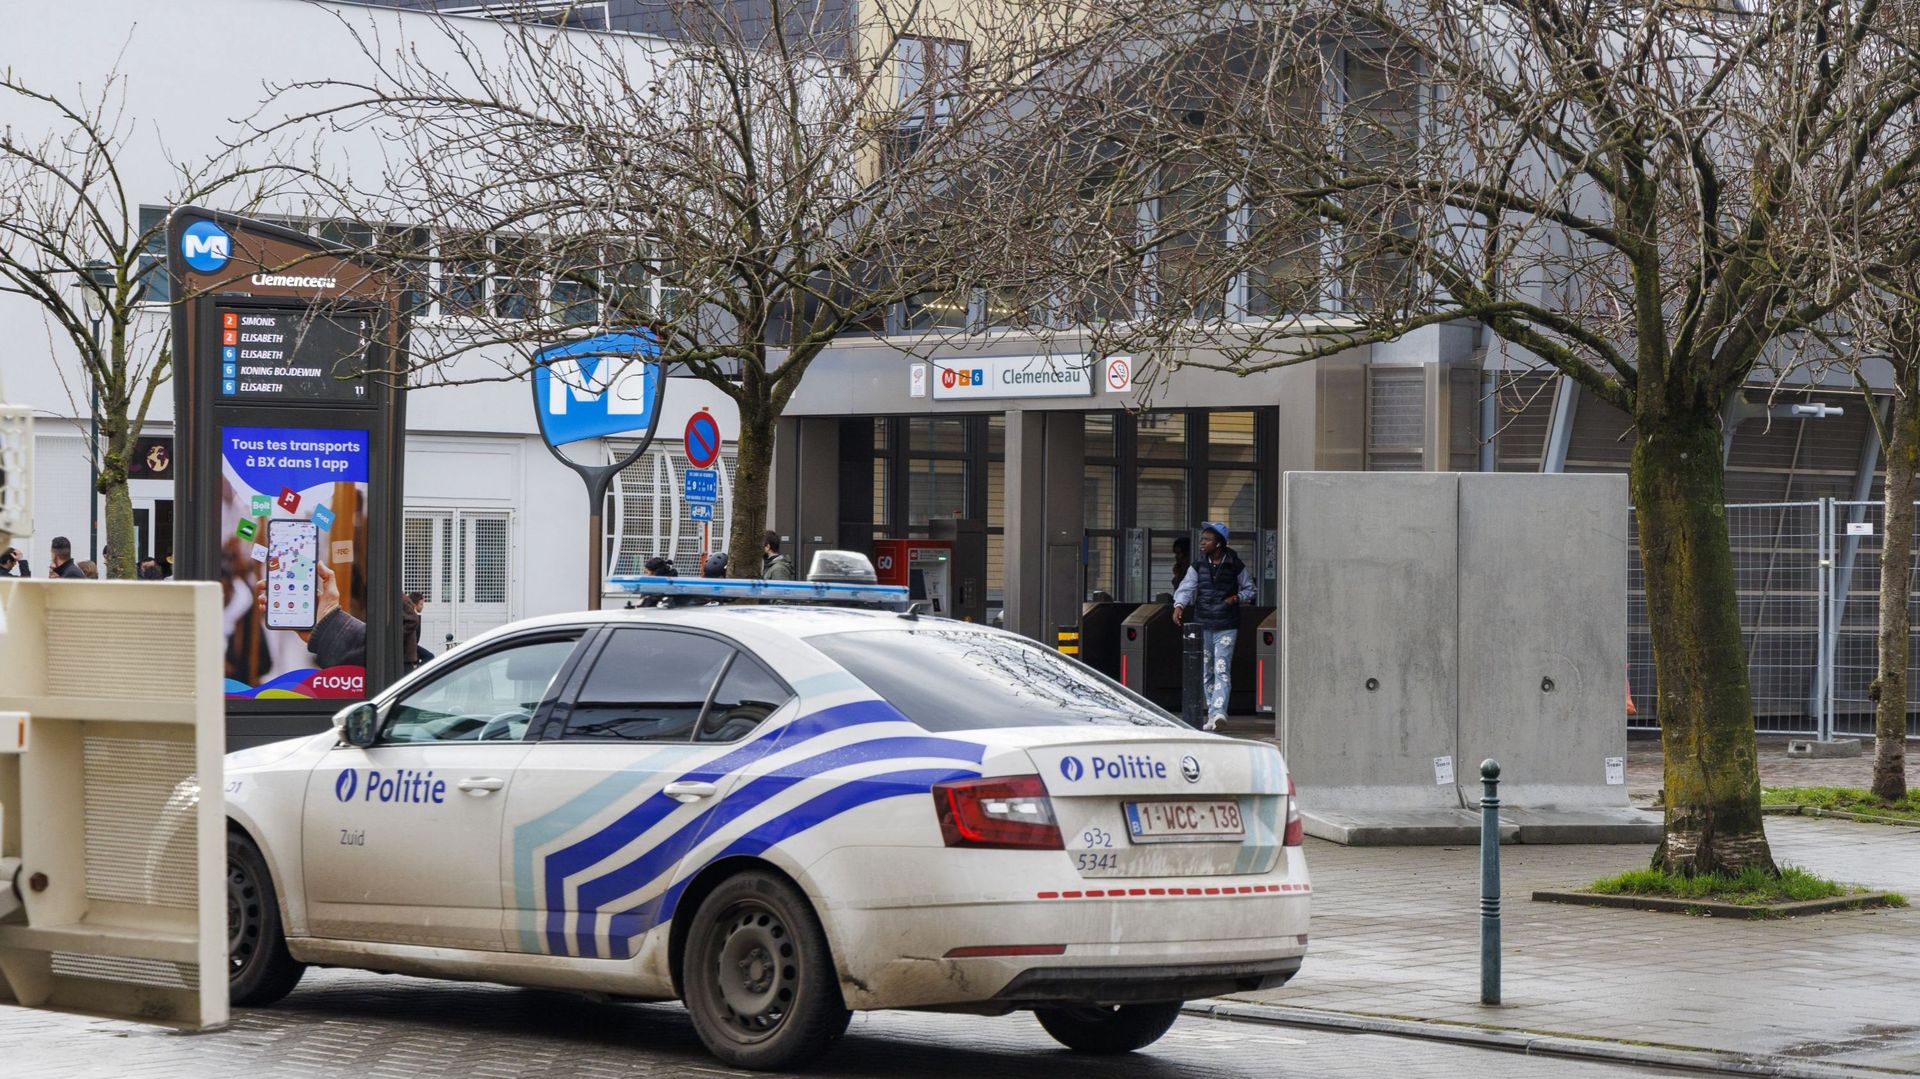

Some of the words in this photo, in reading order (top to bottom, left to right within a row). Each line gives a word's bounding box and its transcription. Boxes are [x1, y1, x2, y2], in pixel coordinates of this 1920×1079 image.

[252, 273, 336, 288] Clemenceau
[241, 317, 276, 327] SIMONIS
[241, 334, 283, 343] ELISABETH
[241, 350, 283, 360] ELISABETH
[240, 366, 273, 376] KONING
[1002, 368, 1081, 385] Clemenceau
[240, 383, 283, 393] ELISABETH
[355, 386, 364, 395] 11
[232, 439, 264, 450] Tous
[267, 440, 287, 451] tes
[290, 440, 360, 455] transports
[246, 455, 255, 467] à
[258, 457, 276, 468] BX
[278, 457, 312, 468] dans
[314, 458, 320, 468] 1
[322, 459, 349, 472] app
[1092, 755, 1167, 779] Politie
[365, 769, 447, 803] Politie
[1132, 821, 1140, 833] B
[340, 829, 365, 846] Zuid
[1084, 828, 1113, 849] 932
[1077, 854, 1118, 871] 5341
